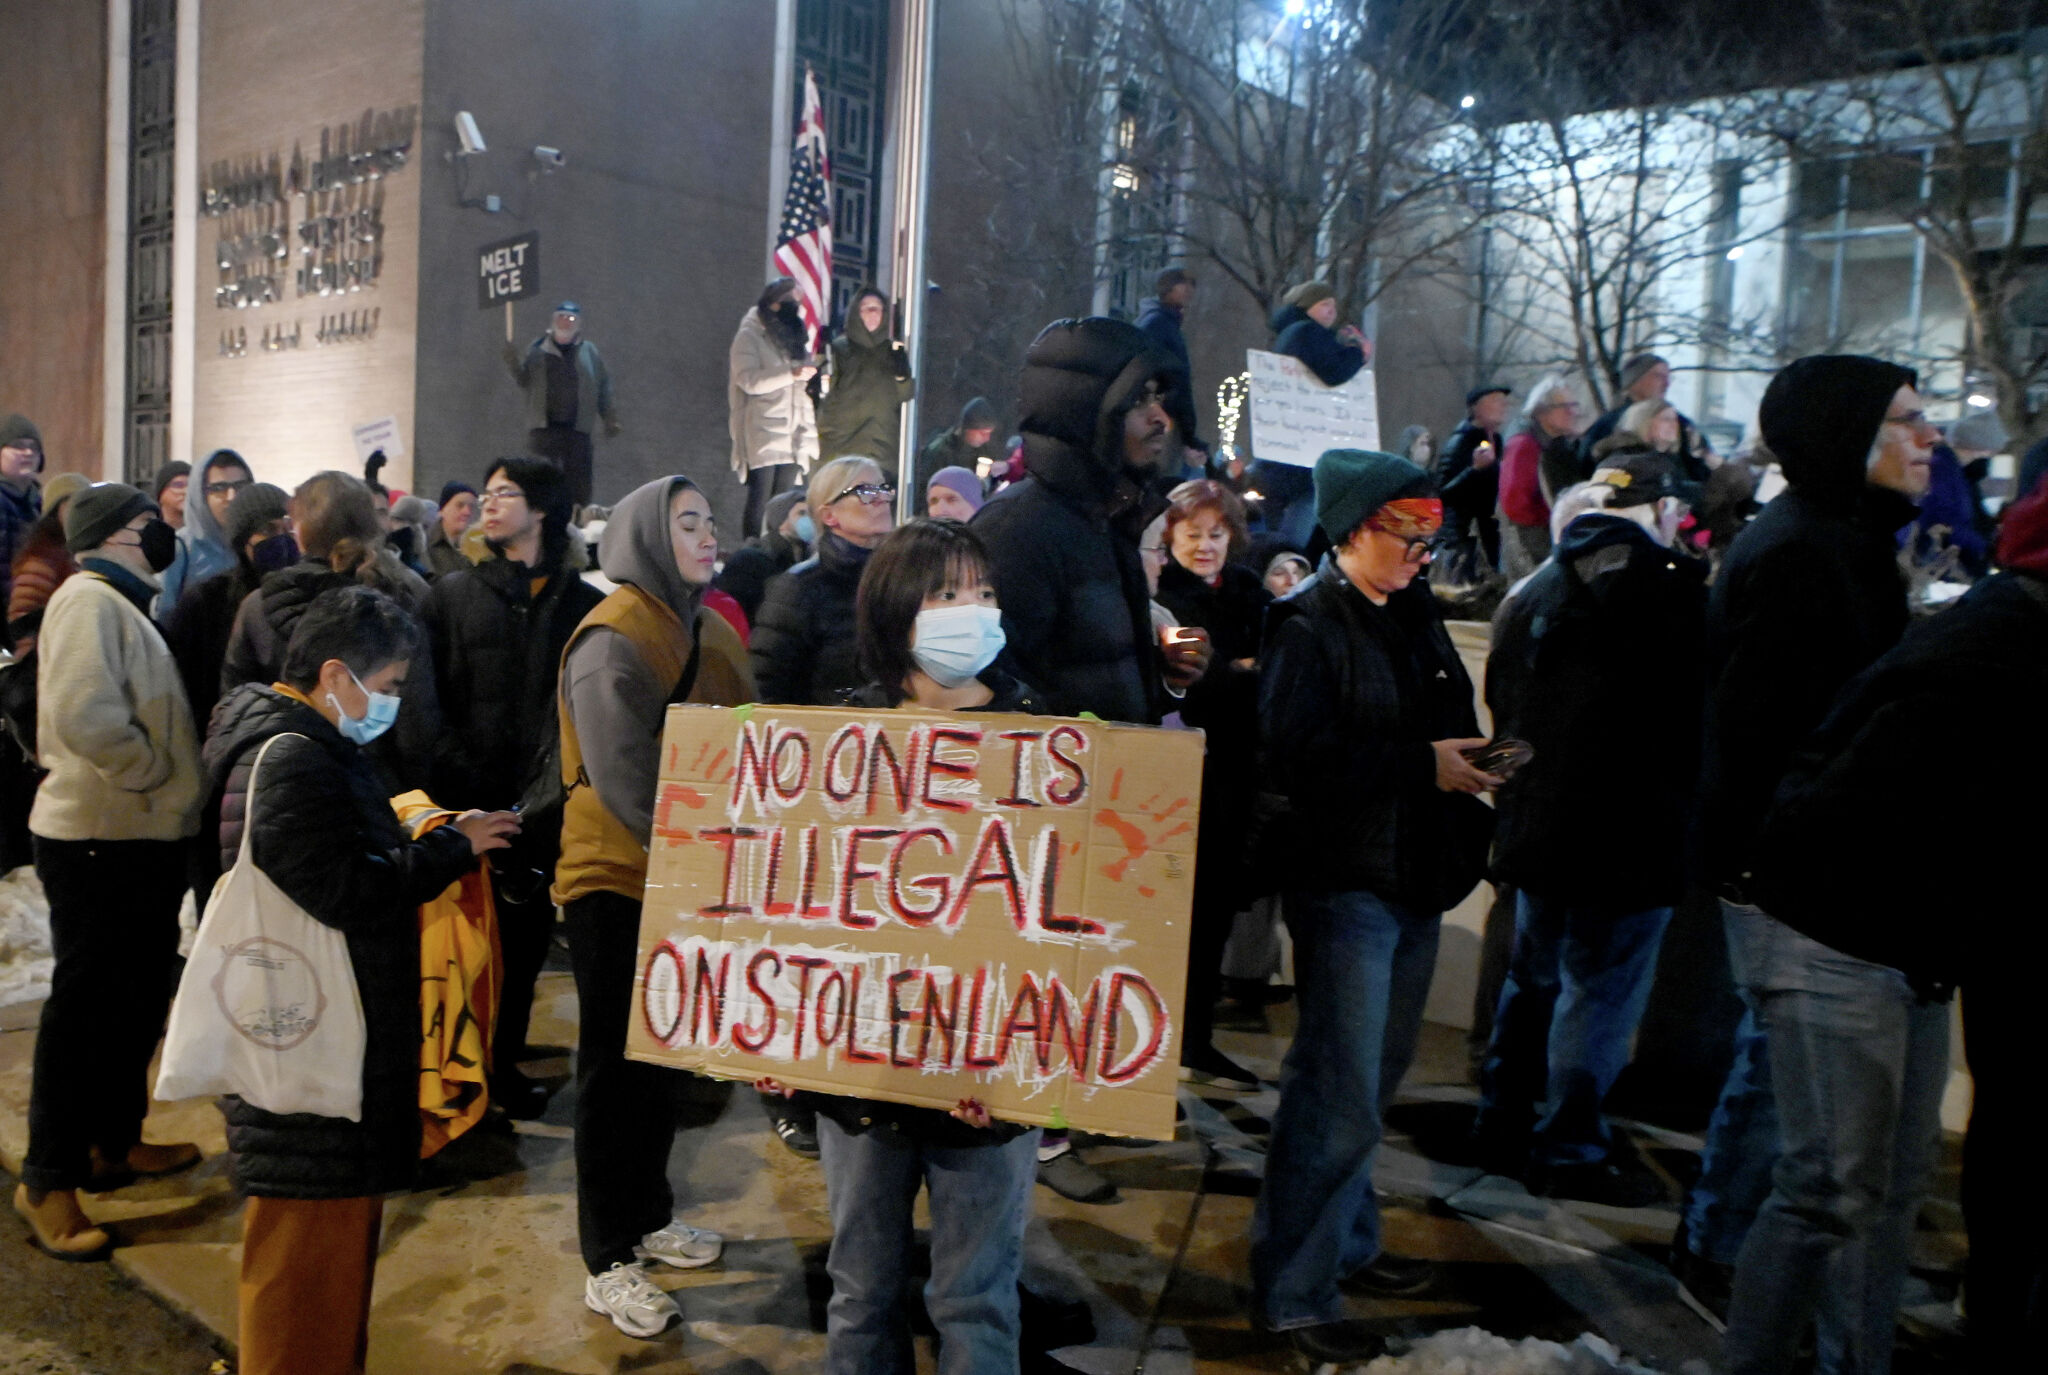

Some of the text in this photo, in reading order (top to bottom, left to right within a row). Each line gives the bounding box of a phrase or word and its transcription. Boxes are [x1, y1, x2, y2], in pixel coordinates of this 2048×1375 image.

[481, 242, 529, 277] MELT
[488, 269, 522, 299] ICE
[732, 722, 1088, 815] NO ONE IS
[697, 818, 1107, 936] ILLEGAL
[642, 938, 1170, 1085] ON STOLEN LAND
